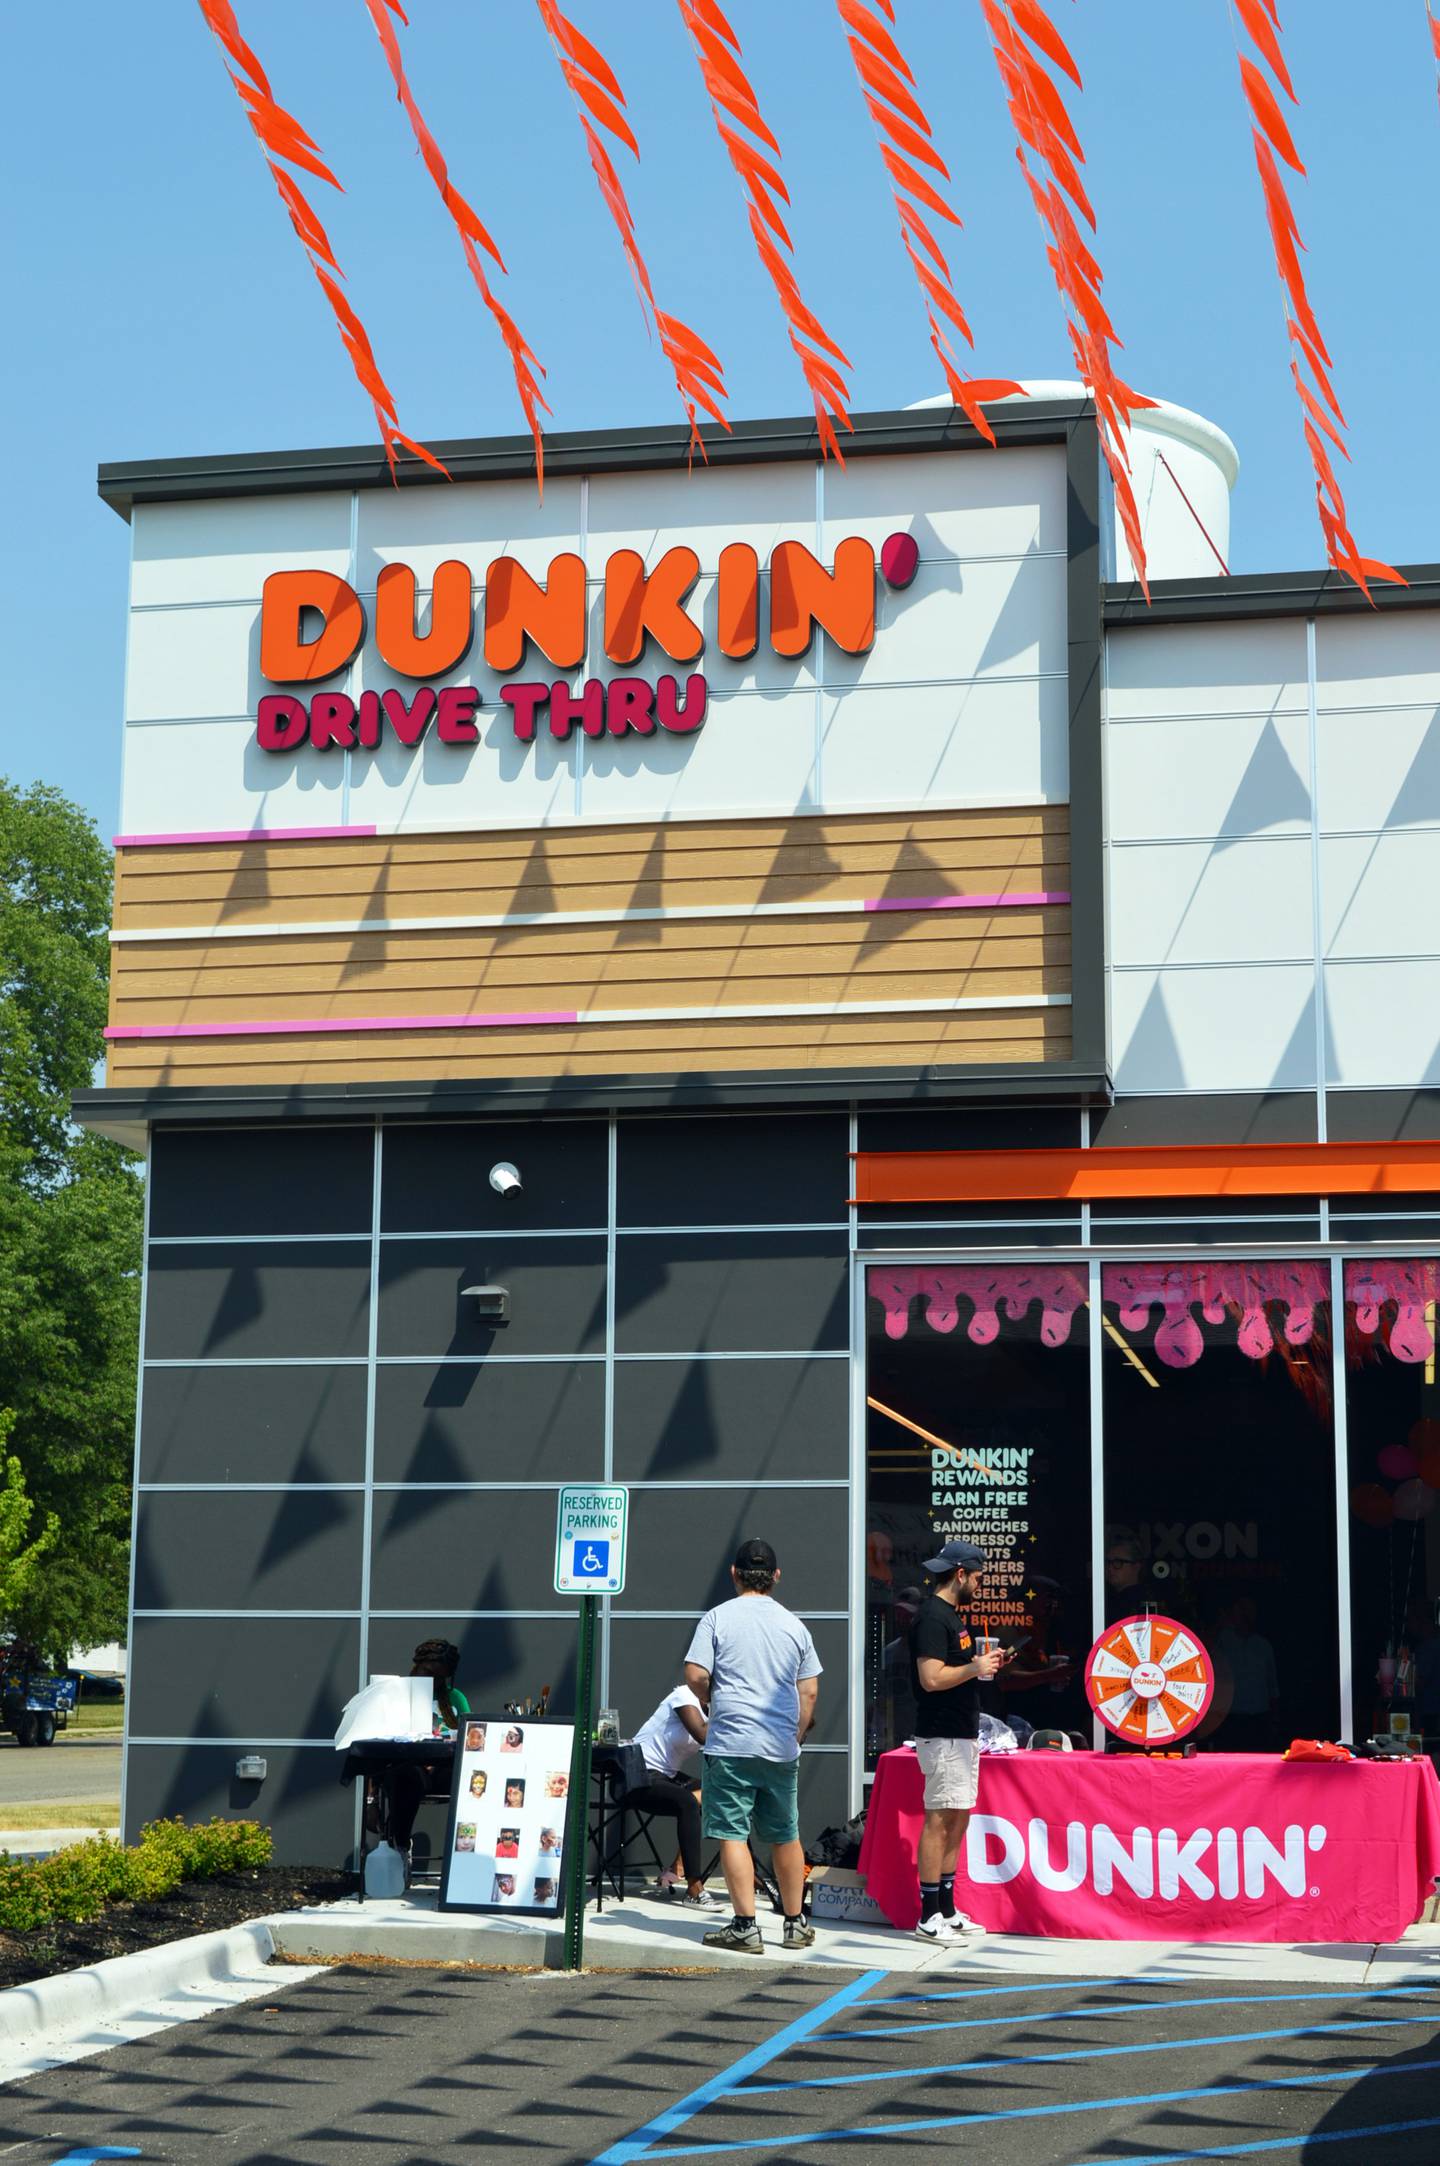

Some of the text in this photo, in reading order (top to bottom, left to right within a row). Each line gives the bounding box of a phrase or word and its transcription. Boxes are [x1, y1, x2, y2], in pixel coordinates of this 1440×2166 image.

[260, 532, 919, 684] DUNKIN'
[256, 673, 708, 753] DRIVE THRU
[931, 1448, 1034, 1468] DUNKIN'
[931, 1470, 1028, 1486] REWARDS
[564, 1496, 622, 1510] RESERVED
[932, 1491, 1028, 1506] EARN FREE
[953, 1508, 1009, 1519] COFFEE
[567, 1514, 618, 1528] PARKING
[932, 1521, 1029, 1532] SANDWICHES
[983, 1575, 1024, 1586] BREW
[972, 1588, 1008, 1599] GELS
[971, 1615, 1034, 1626] BROWNS
[966, 1813, 1327, 1901] DUNKIN'
